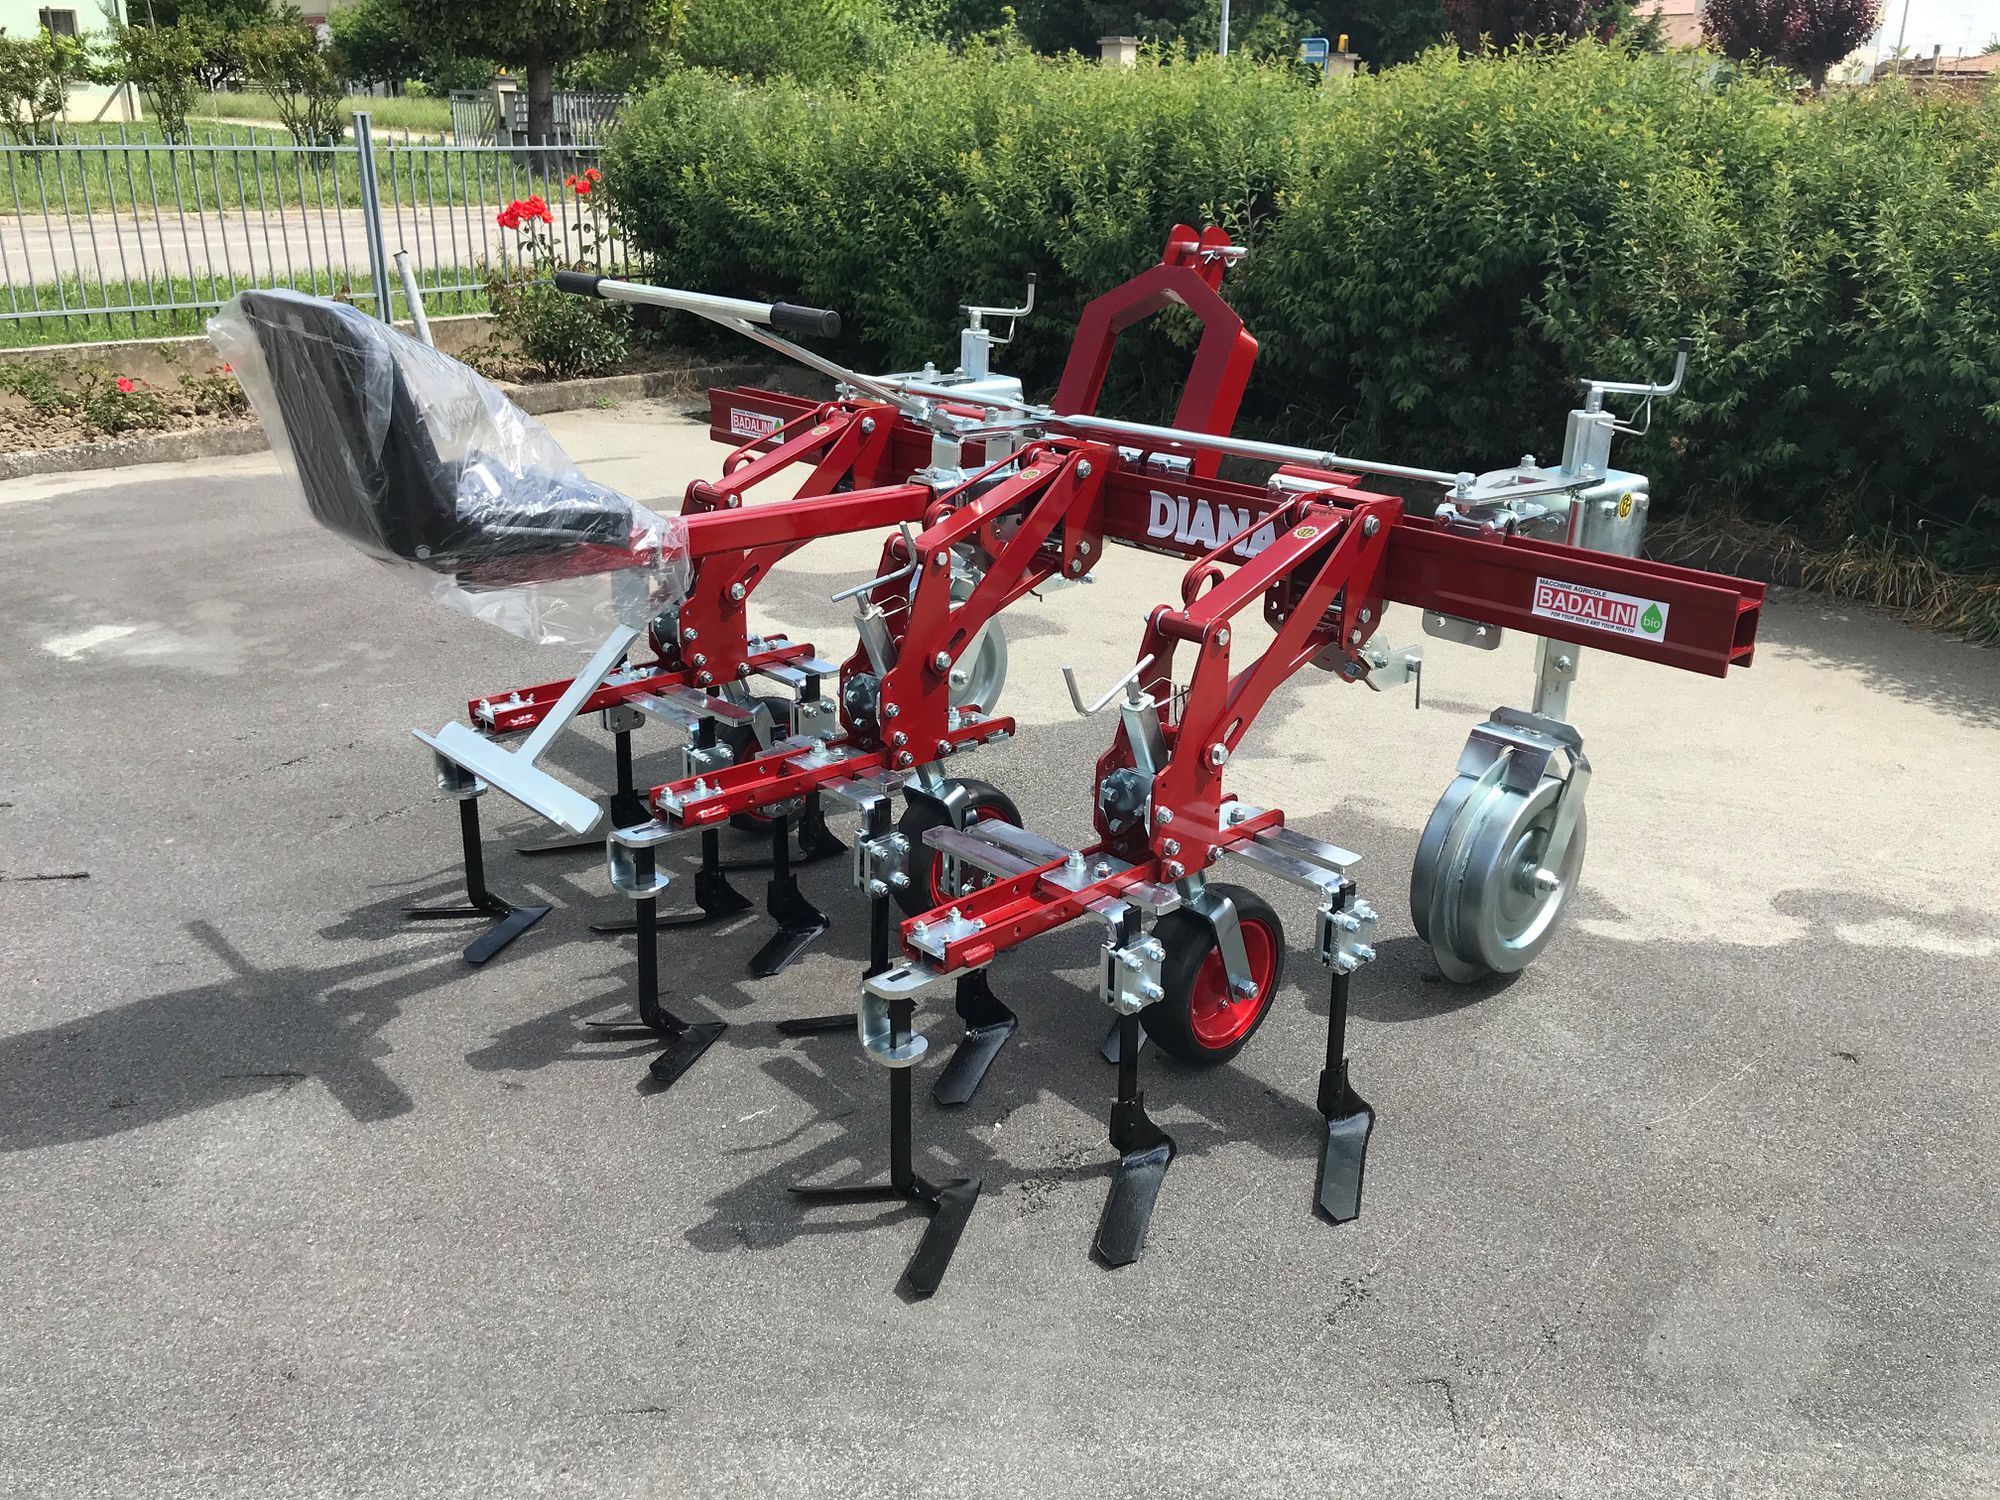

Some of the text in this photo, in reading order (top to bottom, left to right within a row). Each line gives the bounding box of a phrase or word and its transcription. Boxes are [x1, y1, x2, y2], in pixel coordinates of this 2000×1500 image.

[733, 415, 774, 434] BADALINI
[1147, 490, 1277, 558] DIANA
[1540, 579, 1606, 598] MACCHINE AGRICOLE
[1538, 588, 1637, 627] BADALINI
[1643, 616, 1660, 629] bio
